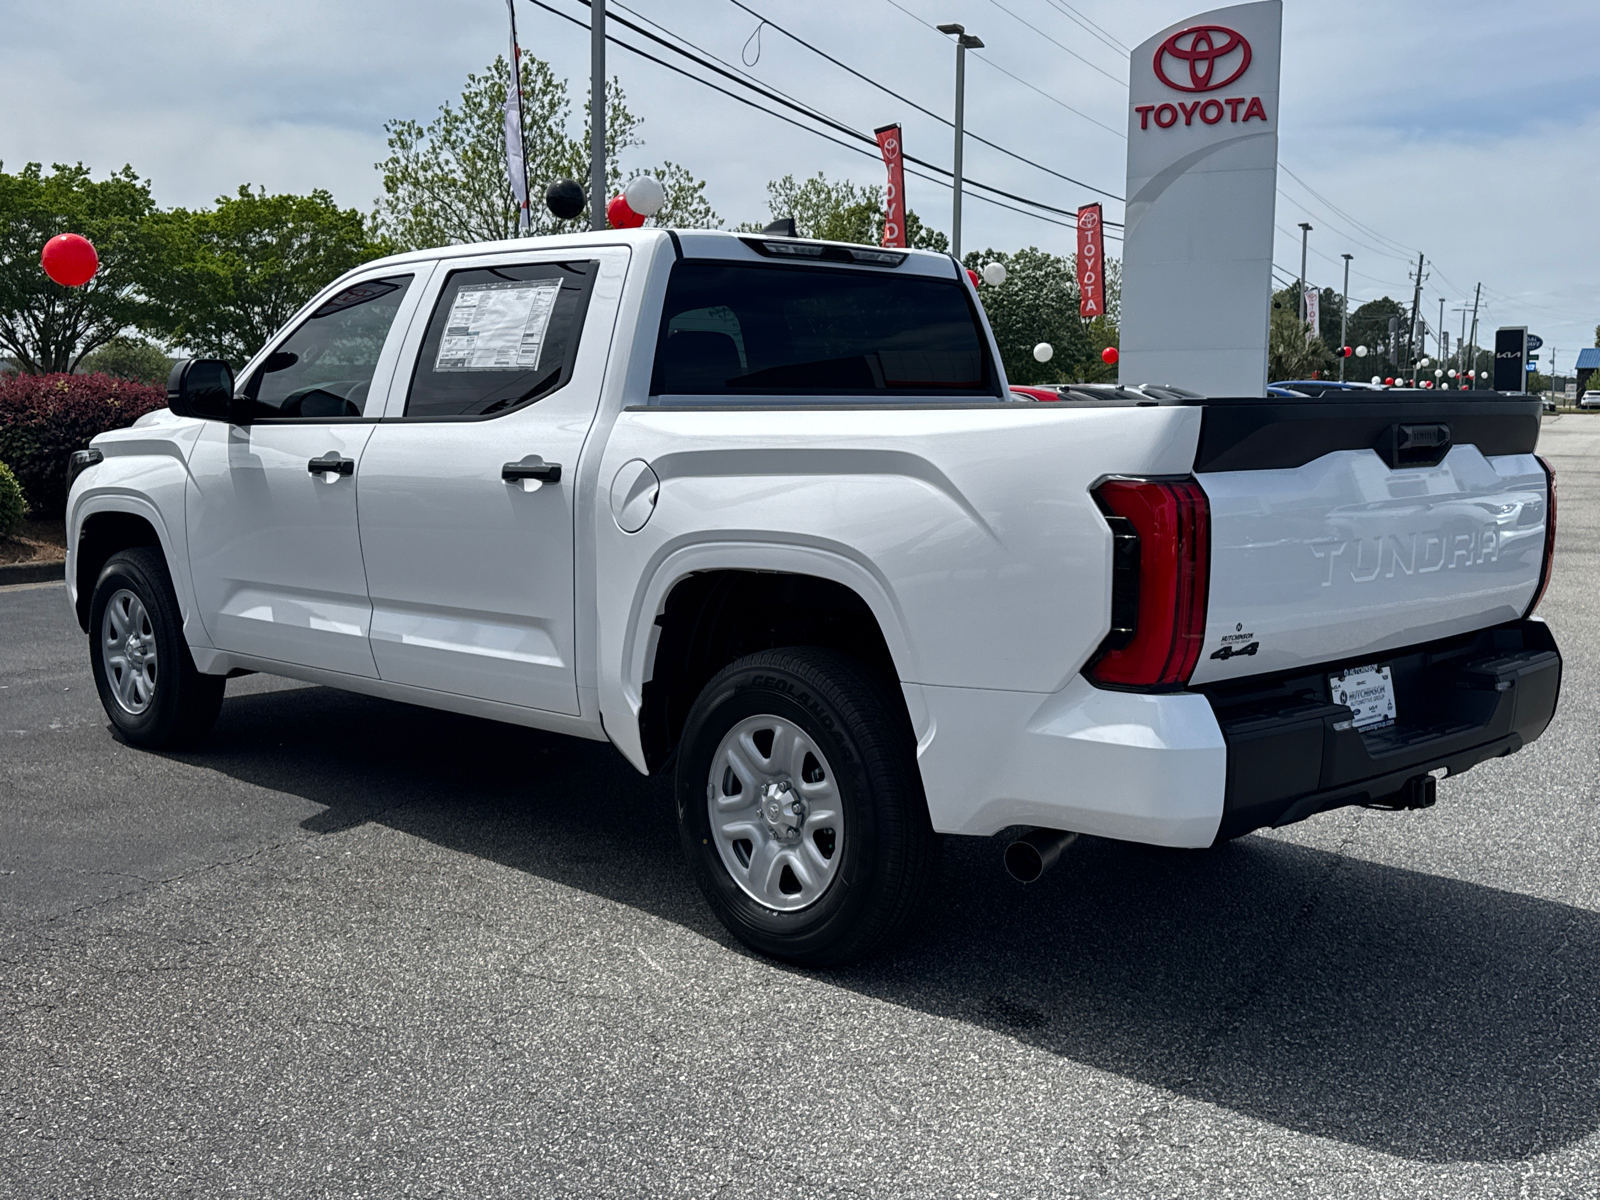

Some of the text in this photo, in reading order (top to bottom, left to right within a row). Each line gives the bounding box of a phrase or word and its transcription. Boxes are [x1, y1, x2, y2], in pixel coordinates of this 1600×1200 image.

[1135, 97, 1267, 130] TOYOTA
[1084, 230, 1097, 312] TOYOTA
[1310, 531, 1498, 587] TUNDRA
[1221, 632, 1254, 642] HUTCHINSON
[1349, 684, 1386, 702] HUTCHINSON
[1351, 693, 1385, 707] AUTOMOTIVE GROUP
[751, 674, 855, 762] GEOLANDAR
